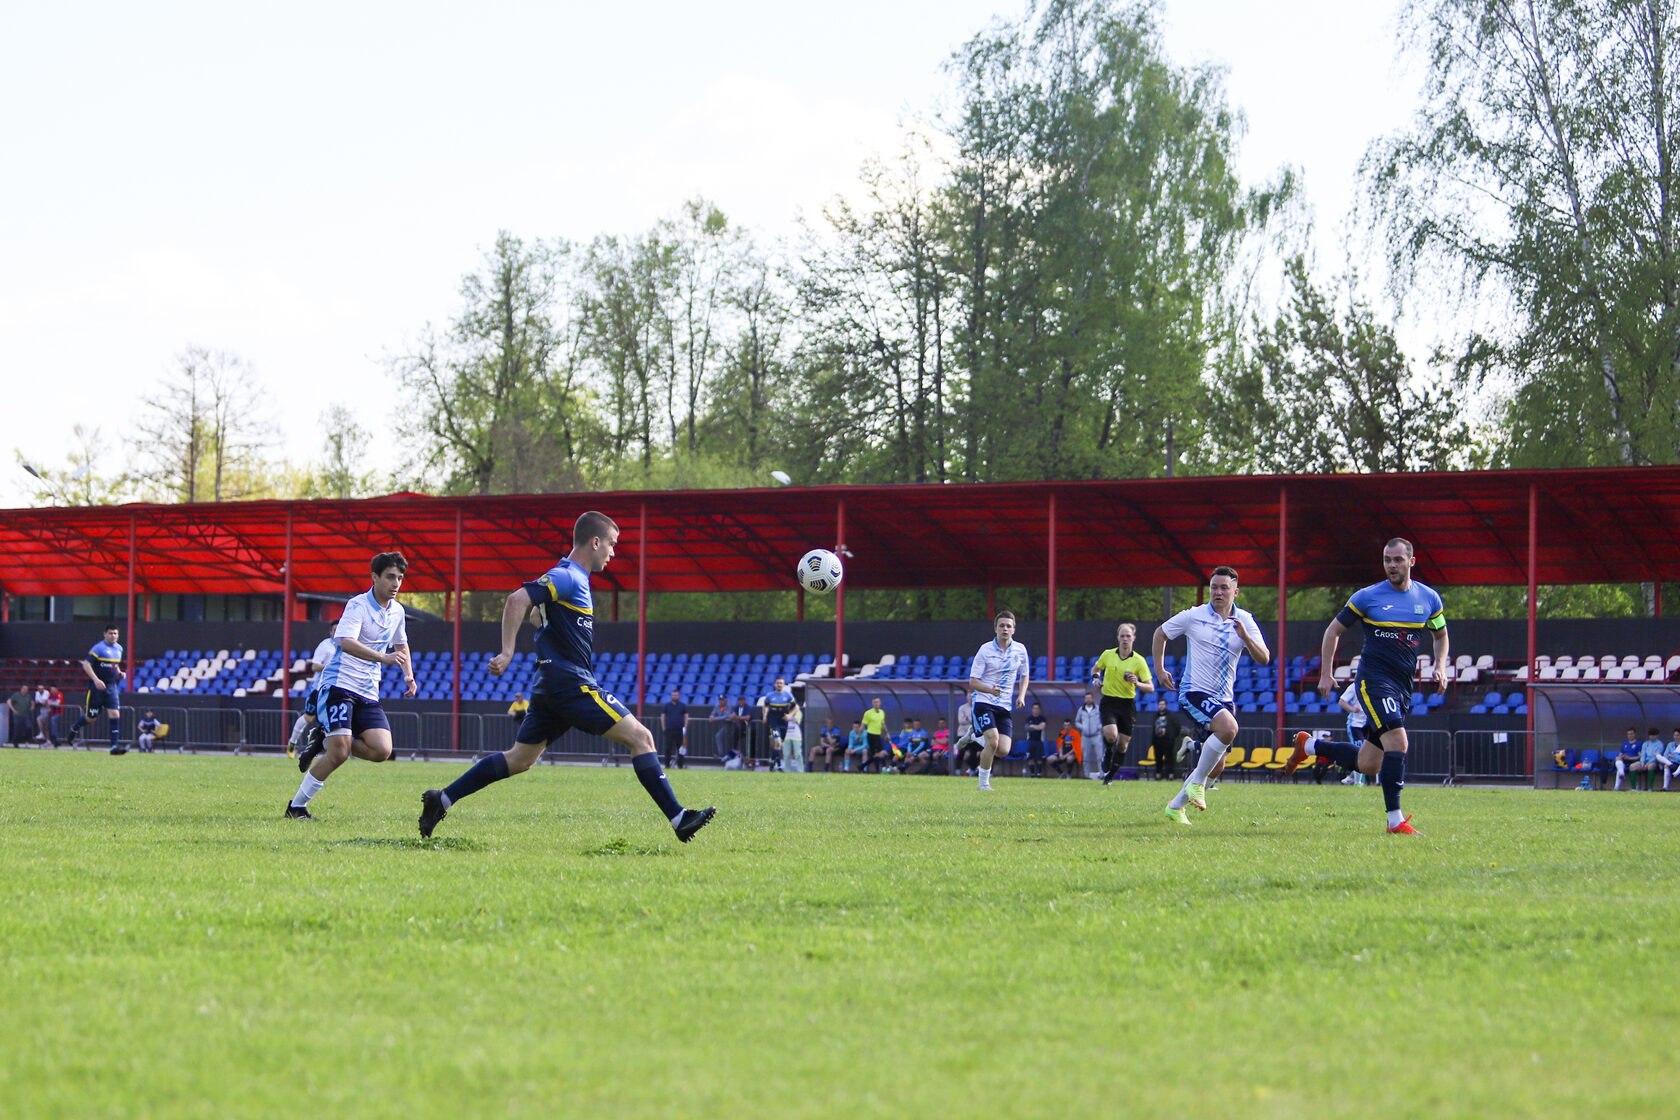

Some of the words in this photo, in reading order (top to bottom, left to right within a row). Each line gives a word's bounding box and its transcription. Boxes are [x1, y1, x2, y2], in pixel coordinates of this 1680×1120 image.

[607, 694, 625, 709] 9
[1382, 696, 1397, 714] 10
[330, 702, 348, 723] 22
[978, 713, 991, 728] 25
